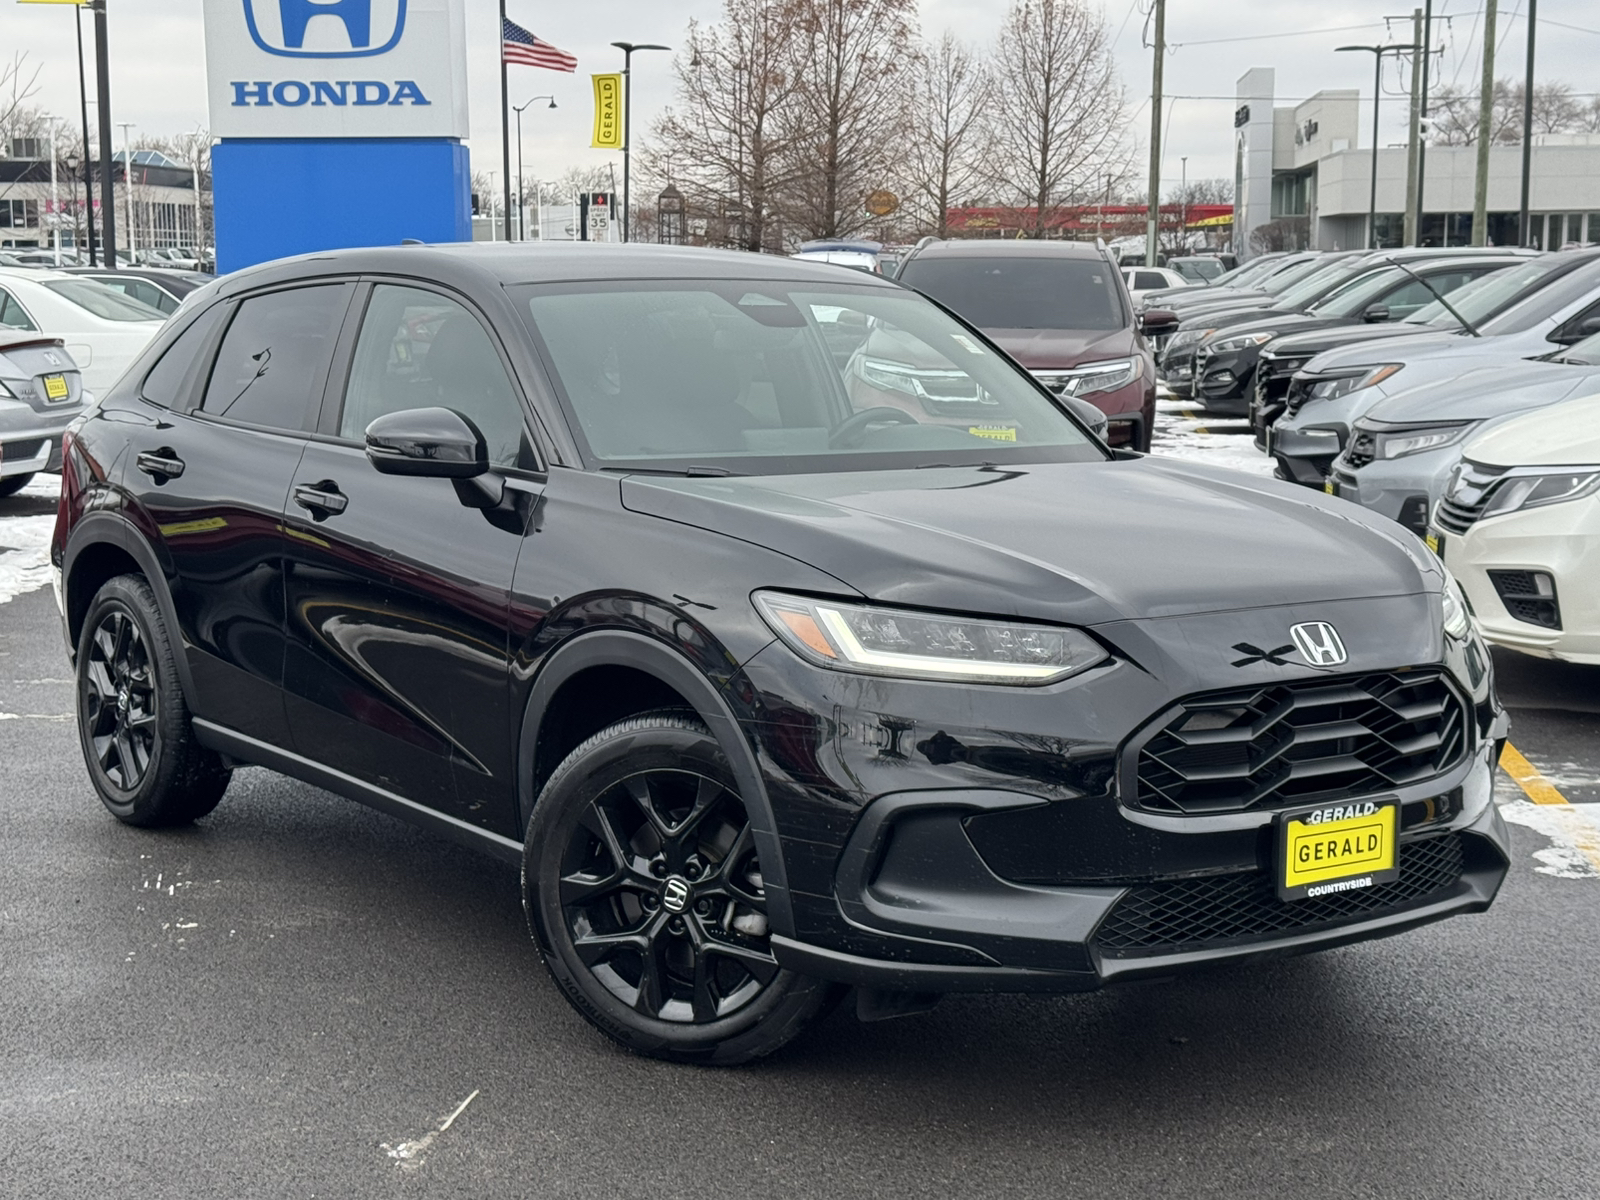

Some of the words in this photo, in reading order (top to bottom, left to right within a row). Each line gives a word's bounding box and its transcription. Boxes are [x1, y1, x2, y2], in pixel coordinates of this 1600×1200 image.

[230, 80, 432, 107] HONDA
[602, 83, 613, 139] GERALD
[590, 218, 607, 228] 35
[1310, 802, 1375, 825] GERALD
[1298, 834, 1378, 863] GERALD
[1308, 877, 1372, 897] COUNTRYSIDE
